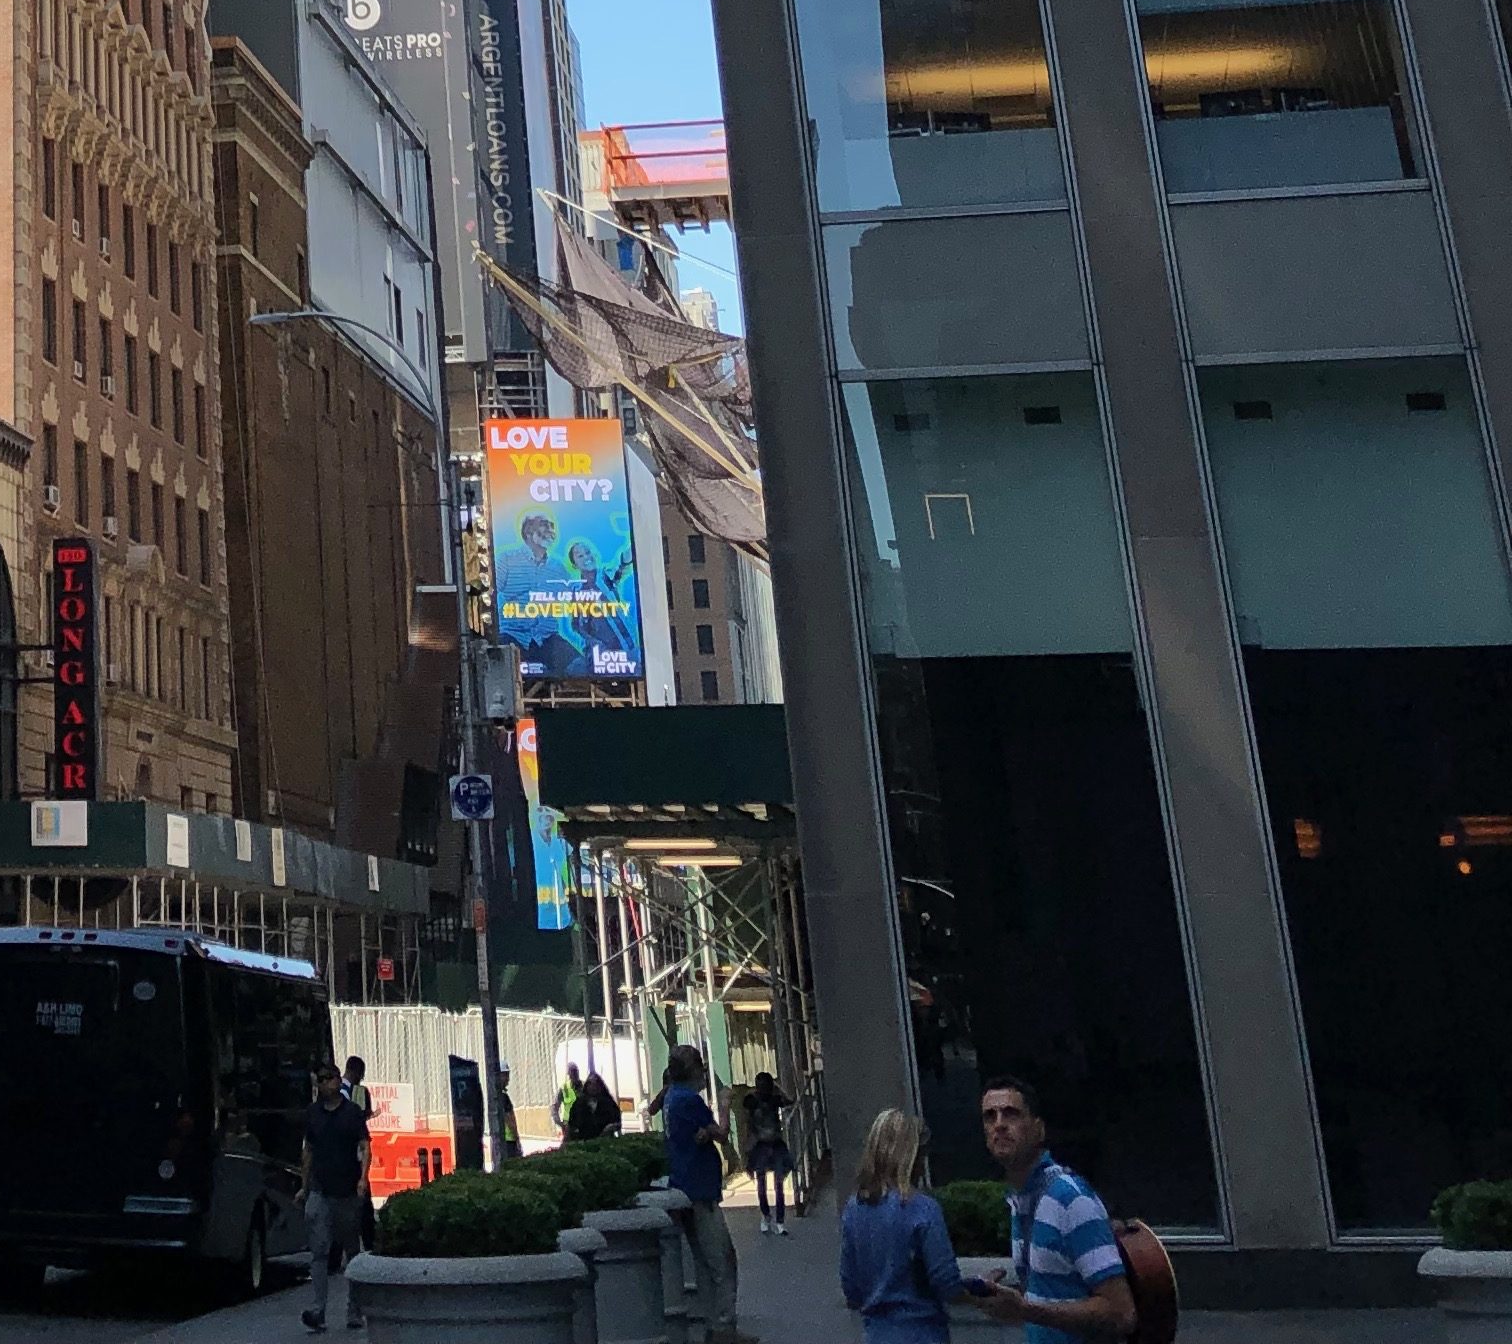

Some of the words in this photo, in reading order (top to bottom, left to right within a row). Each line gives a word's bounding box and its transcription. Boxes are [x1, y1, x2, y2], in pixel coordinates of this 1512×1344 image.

[355, 36, 403, 52] EATS
[406, 32, 441, 48] PRO
[478, 13, 514, 245] ARGENTLOANS.COM
[490, 426, 569, 450] LOVE
[510, 453, 593, 476] YOUR
[529, 478, 614, 502] CITY?
[529, 591, 556, 602] TELL
[557, 591, 573, 601] US
[575, 591, 603, 601] WHY
[502, 602, 630, 619] #LOVEMYCITY
[606, 662, 637, 674] CITY
[59, 568, 87, 789] LONGACR
[369, 1085, 399, 1100] ARTIAL
[376, 1100, 393, 1114] ANE
[369, 1115, 402, 1129] LOSURE
